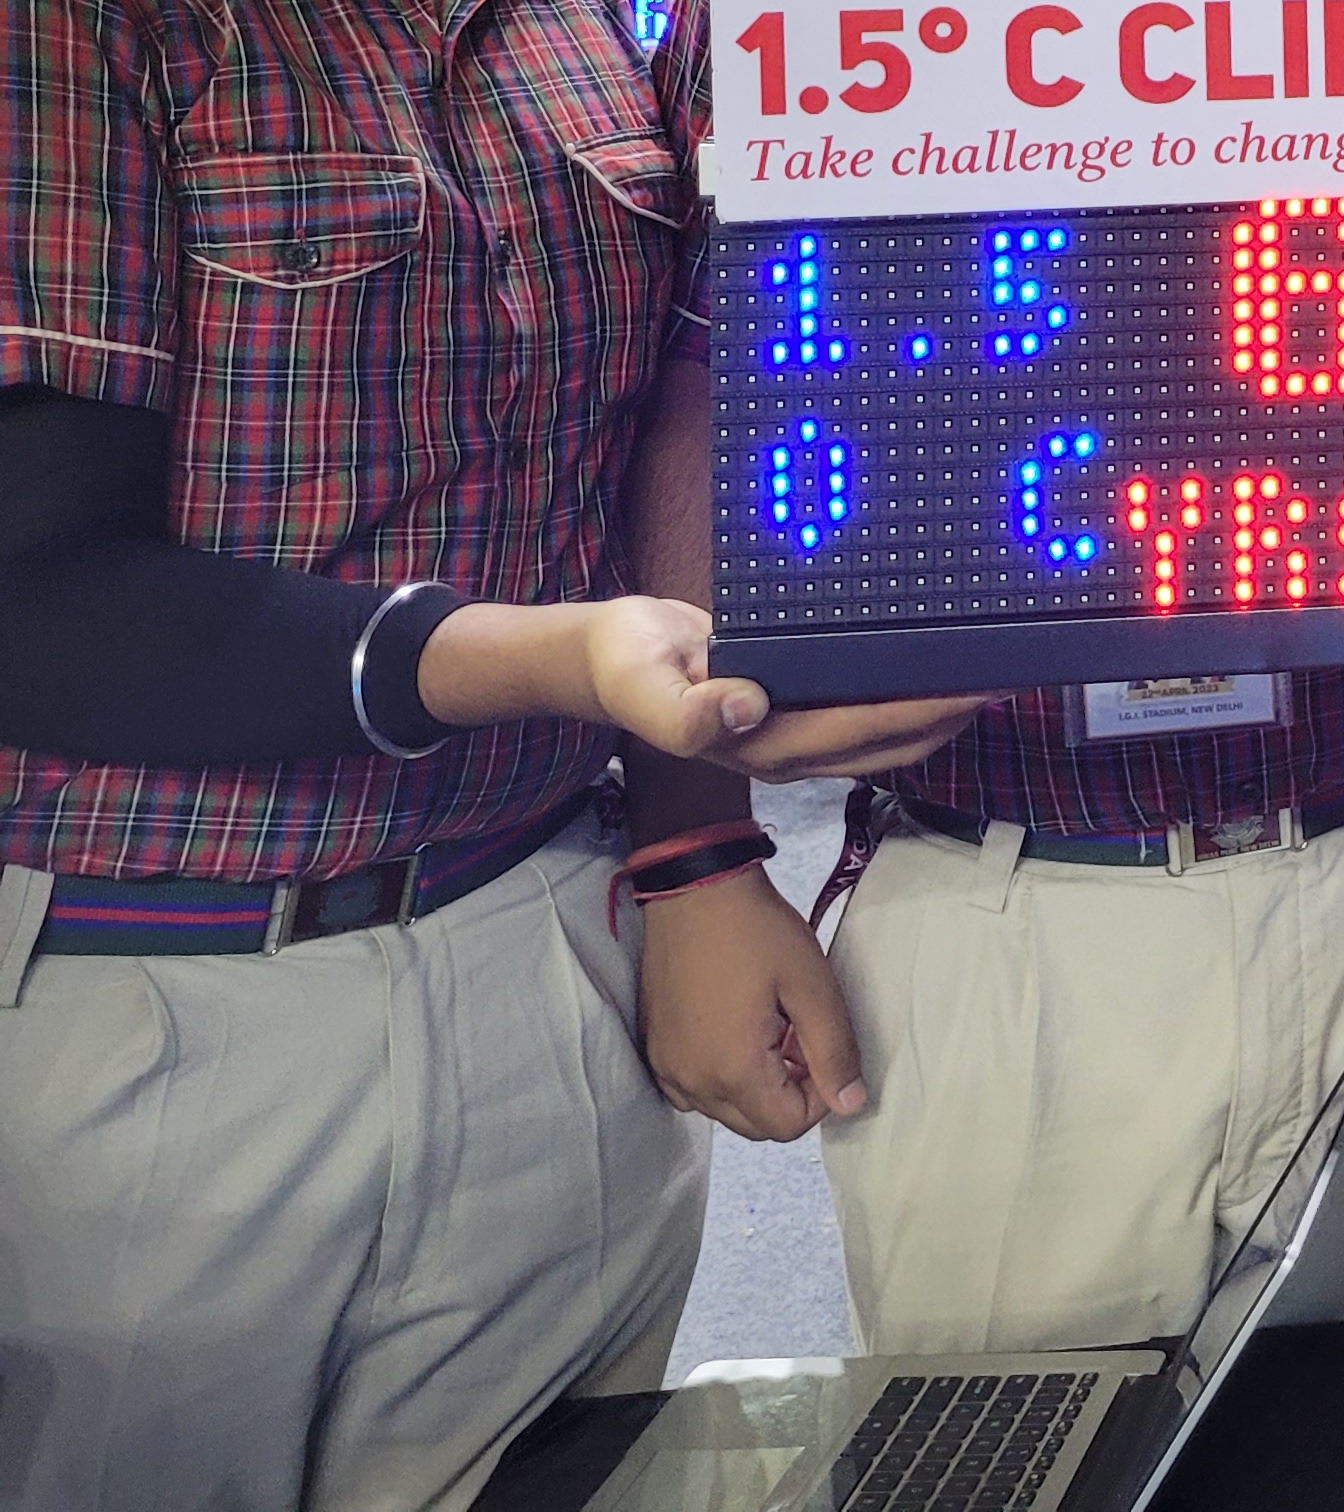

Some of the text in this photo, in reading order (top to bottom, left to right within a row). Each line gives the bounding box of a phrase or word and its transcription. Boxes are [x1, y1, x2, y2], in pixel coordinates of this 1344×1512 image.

[735, 6, 969, 117] 1.5°
[1004, 4, 1085, 109] C
[747, 135, 874, 182] Take
[891, 129, 1133, 182] challenge
[1151, 132, 1197, 167] to
[1018, 432, 1096, 564] C
[1191, 705, 1213, 714] NEW
[1216, 702, 1243, 713] DELHI
